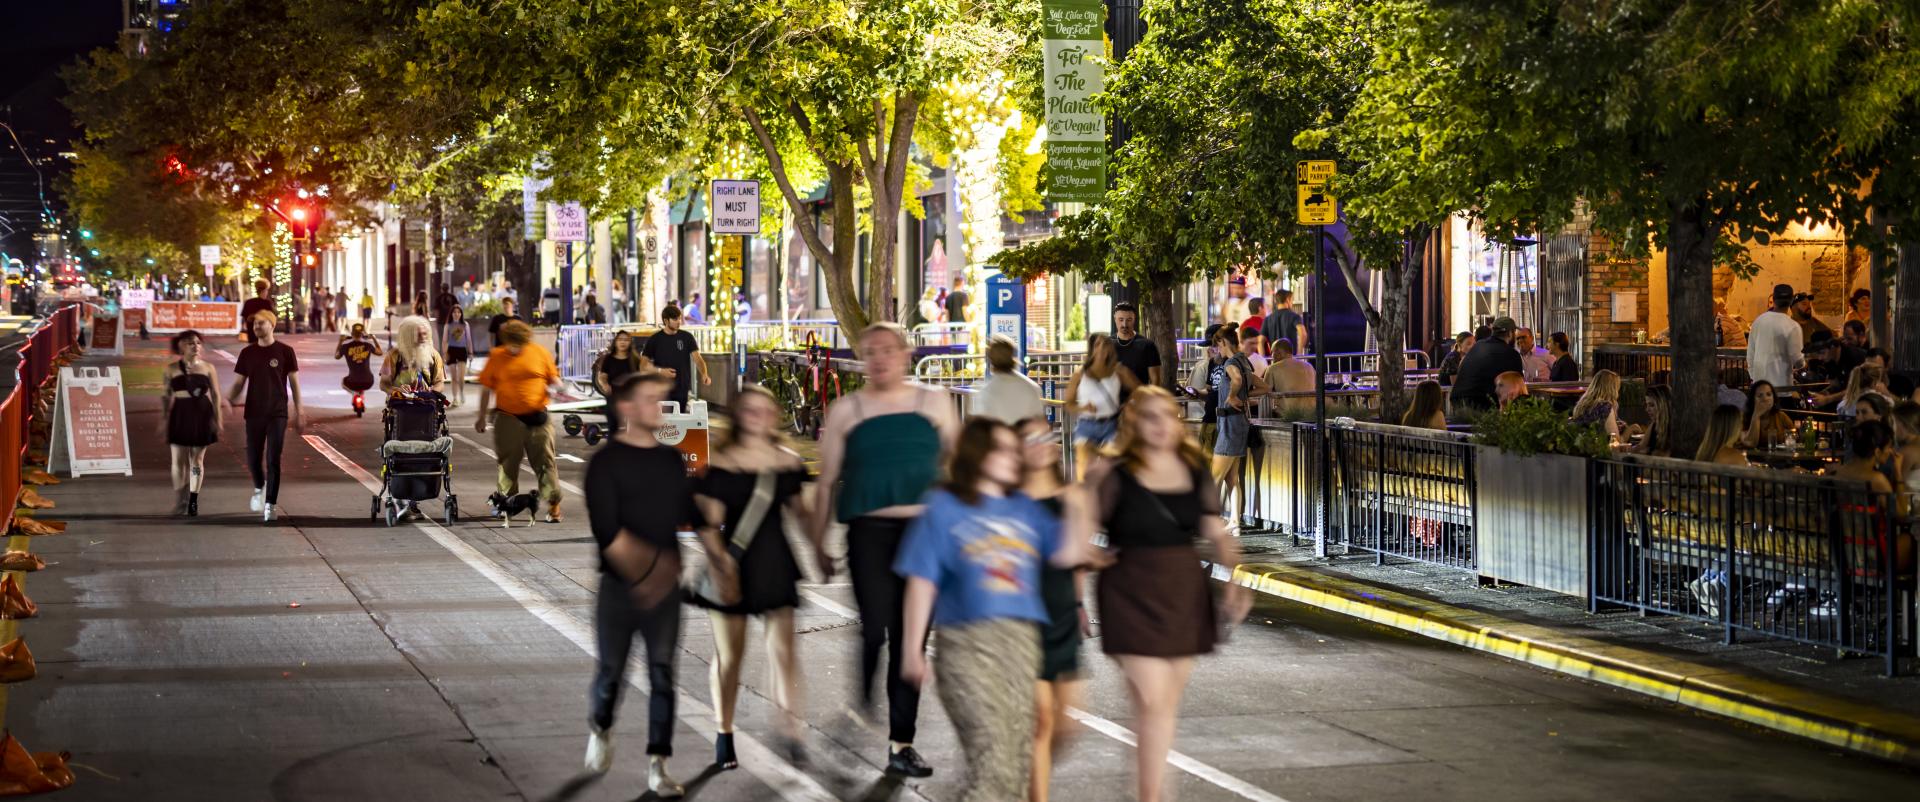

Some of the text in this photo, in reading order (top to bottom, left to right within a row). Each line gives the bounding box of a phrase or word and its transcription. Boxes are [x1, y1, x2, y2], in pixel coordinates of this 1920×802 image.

[1047, 9, 1098, 23] Salt Lake City
[1058, 45, 1088, 68] For
[1054, 70, 1085, 90] The
[1048, 119, 1101, 136] Go Vegan!
[1048, 144, 1092, 156] September
[1074, 157, 1102, 170] Square
[1311, 164, 1330, 172] MINUTE
[1299, 164, 1308, 181] 30
[716, 186, 756, 196] RIGHT LANE
[725, 202, 747, 212] MUST
[717, 218, 755, 227] TURN RIGHT
[998, 289, 1013, 308] P
[997, 325, 1014, 333] SLC
